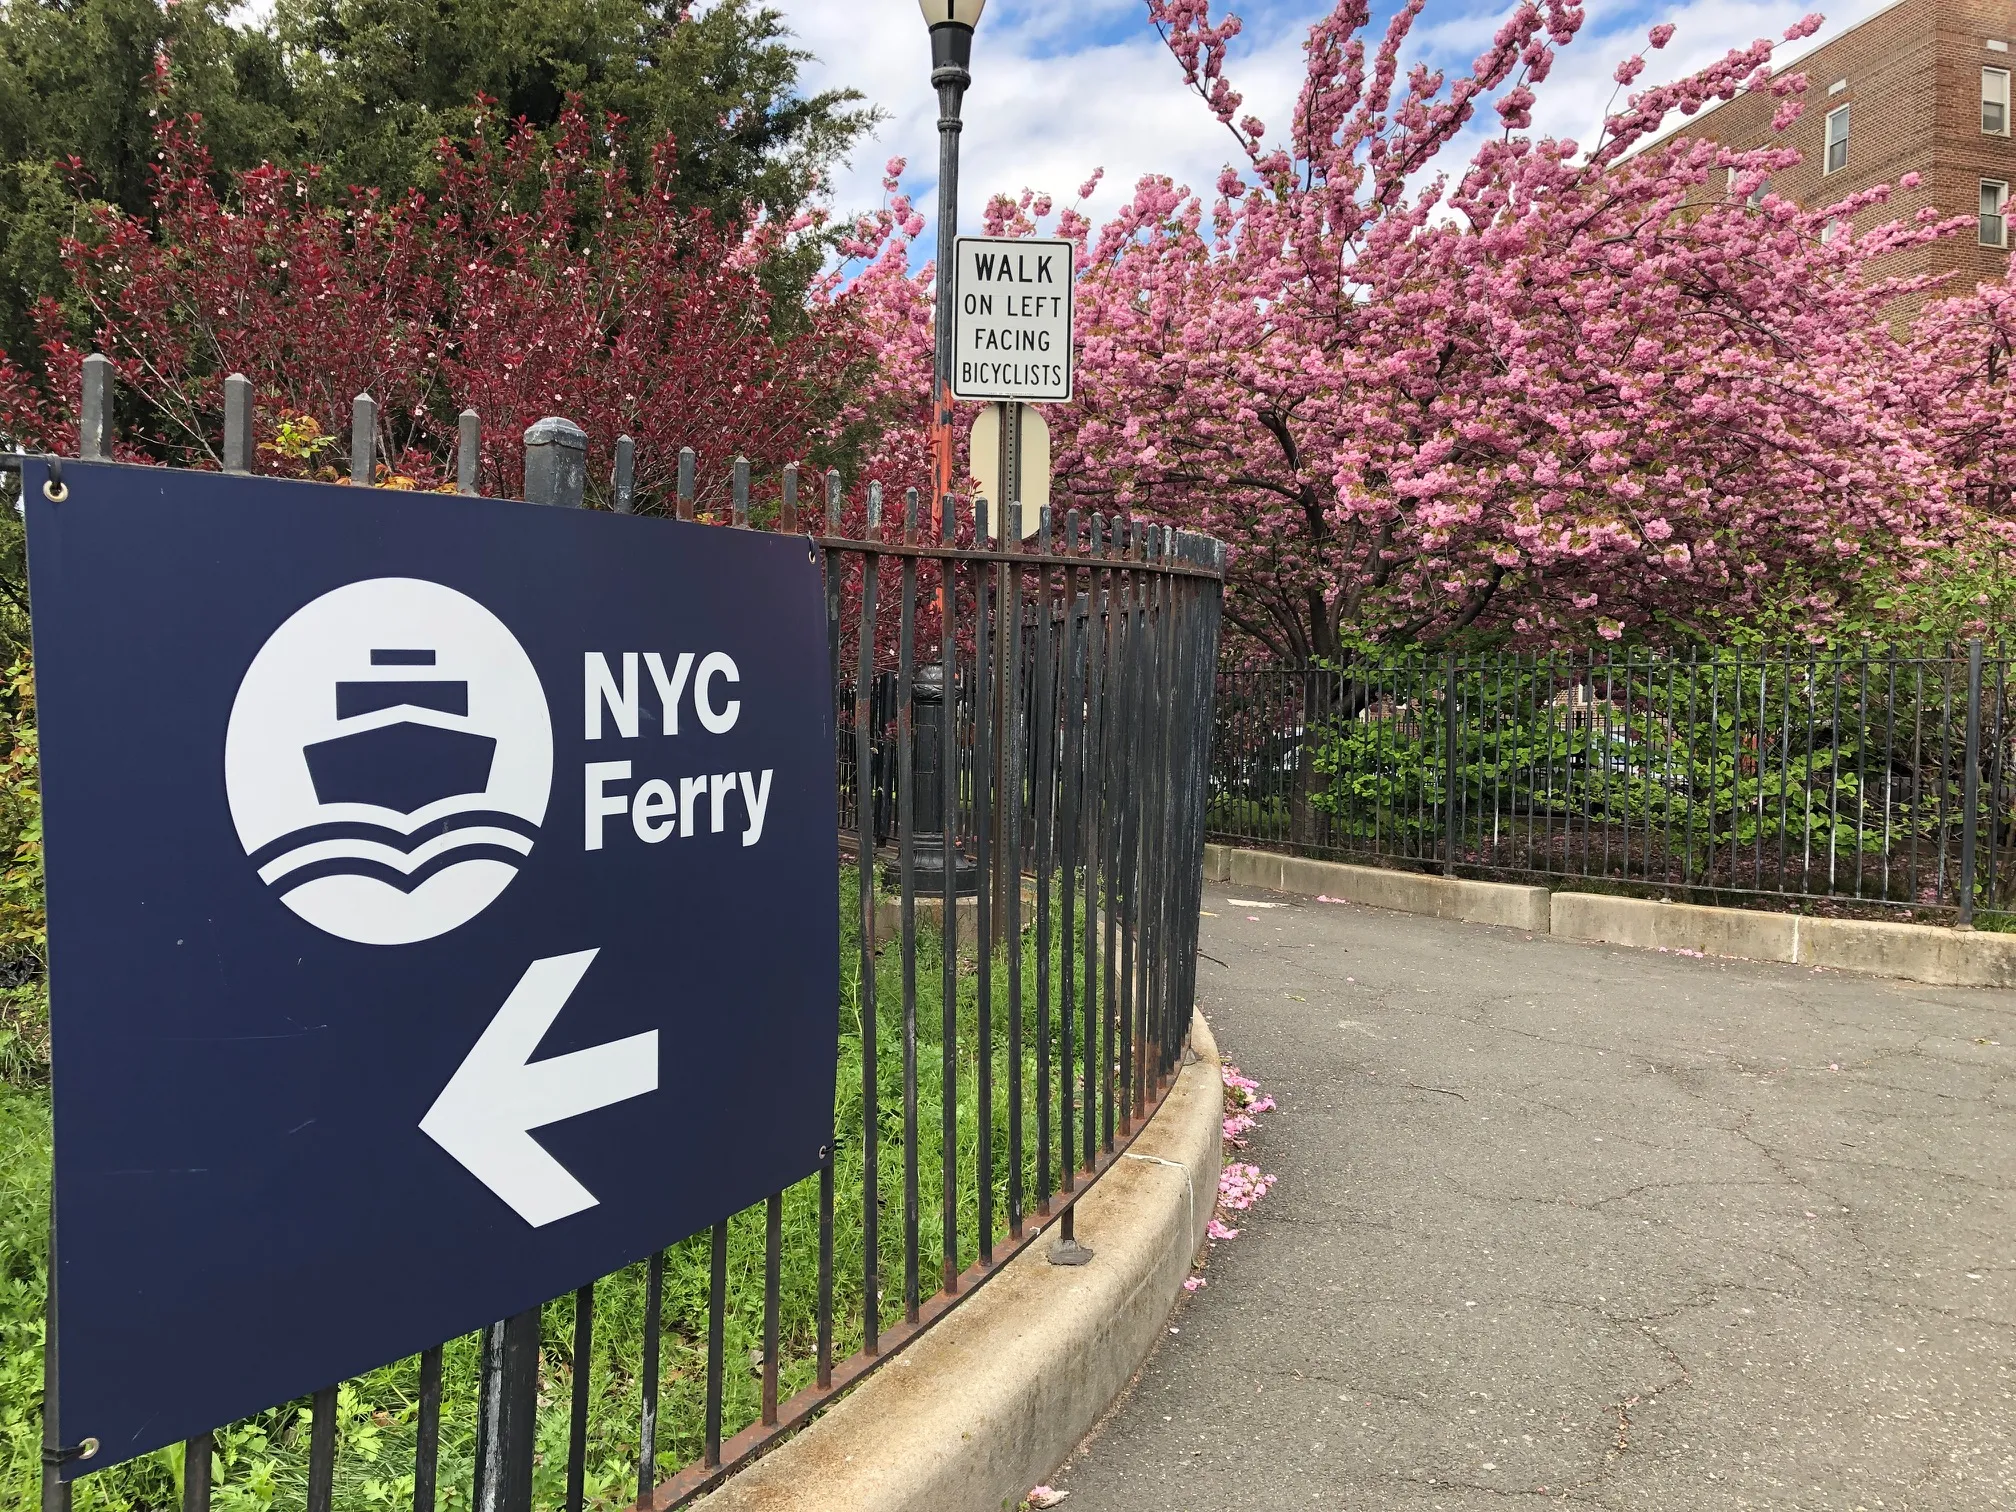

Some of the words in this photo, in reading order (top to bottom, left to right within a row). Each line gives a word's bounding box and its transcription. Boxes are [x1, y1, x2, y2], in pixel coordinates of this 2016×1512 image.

[974, 252, 1053, 284] WALK
[964, 293, 993, 316] ON
[1007, 295, 1062, 318] LEFT
[975, 328, 1050, 352] FACING
[962, 362, 1061, 386] BICYCLISTS
[584, 651, 741, 740] NYC
[584, 759, 774, 851] Ferry
